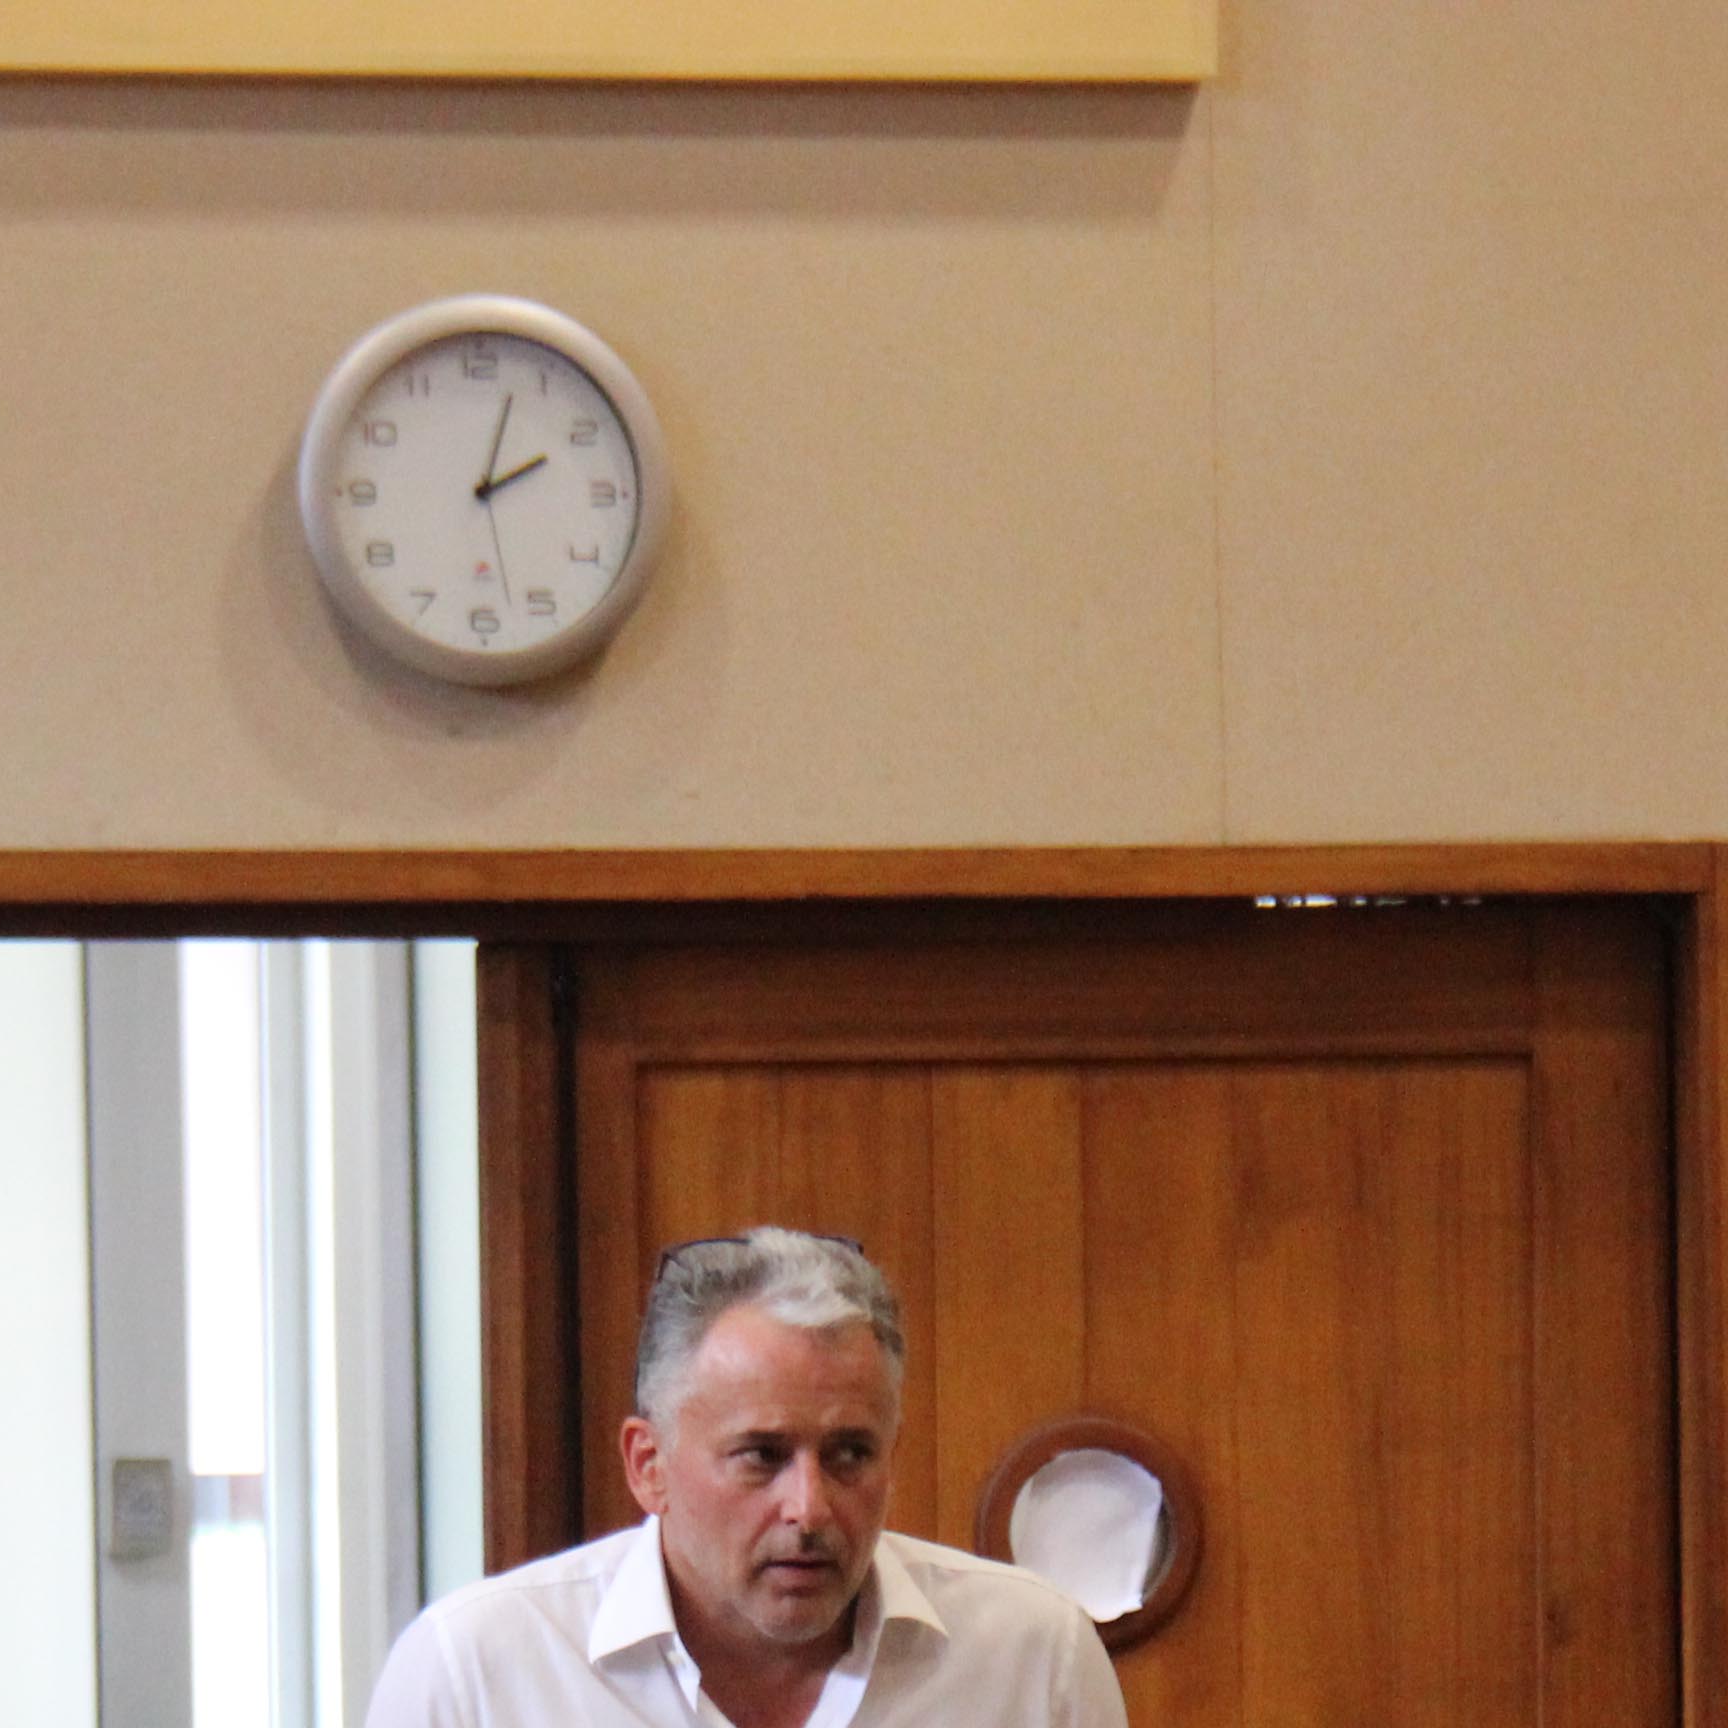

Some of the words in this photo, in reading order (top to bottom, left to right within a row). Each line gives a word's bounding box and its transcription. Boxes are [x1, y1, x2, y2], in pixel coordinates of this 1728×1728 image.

[462, 352, 498, 380] 12
[404, 373, 430, 397] 11
[363, 420, 399, 447] 10
[570, 419, 599, 447] 2
[348, 479, 377, 507] 9
[589, 480, 617, 508] 3
[365, 541, 394, 568] 8
[570, 543, 599, 566] 4
[410, 590, 437, 617] 7
[527, 588, 558, 617] 5
[468, 608, 501, 635] 6
